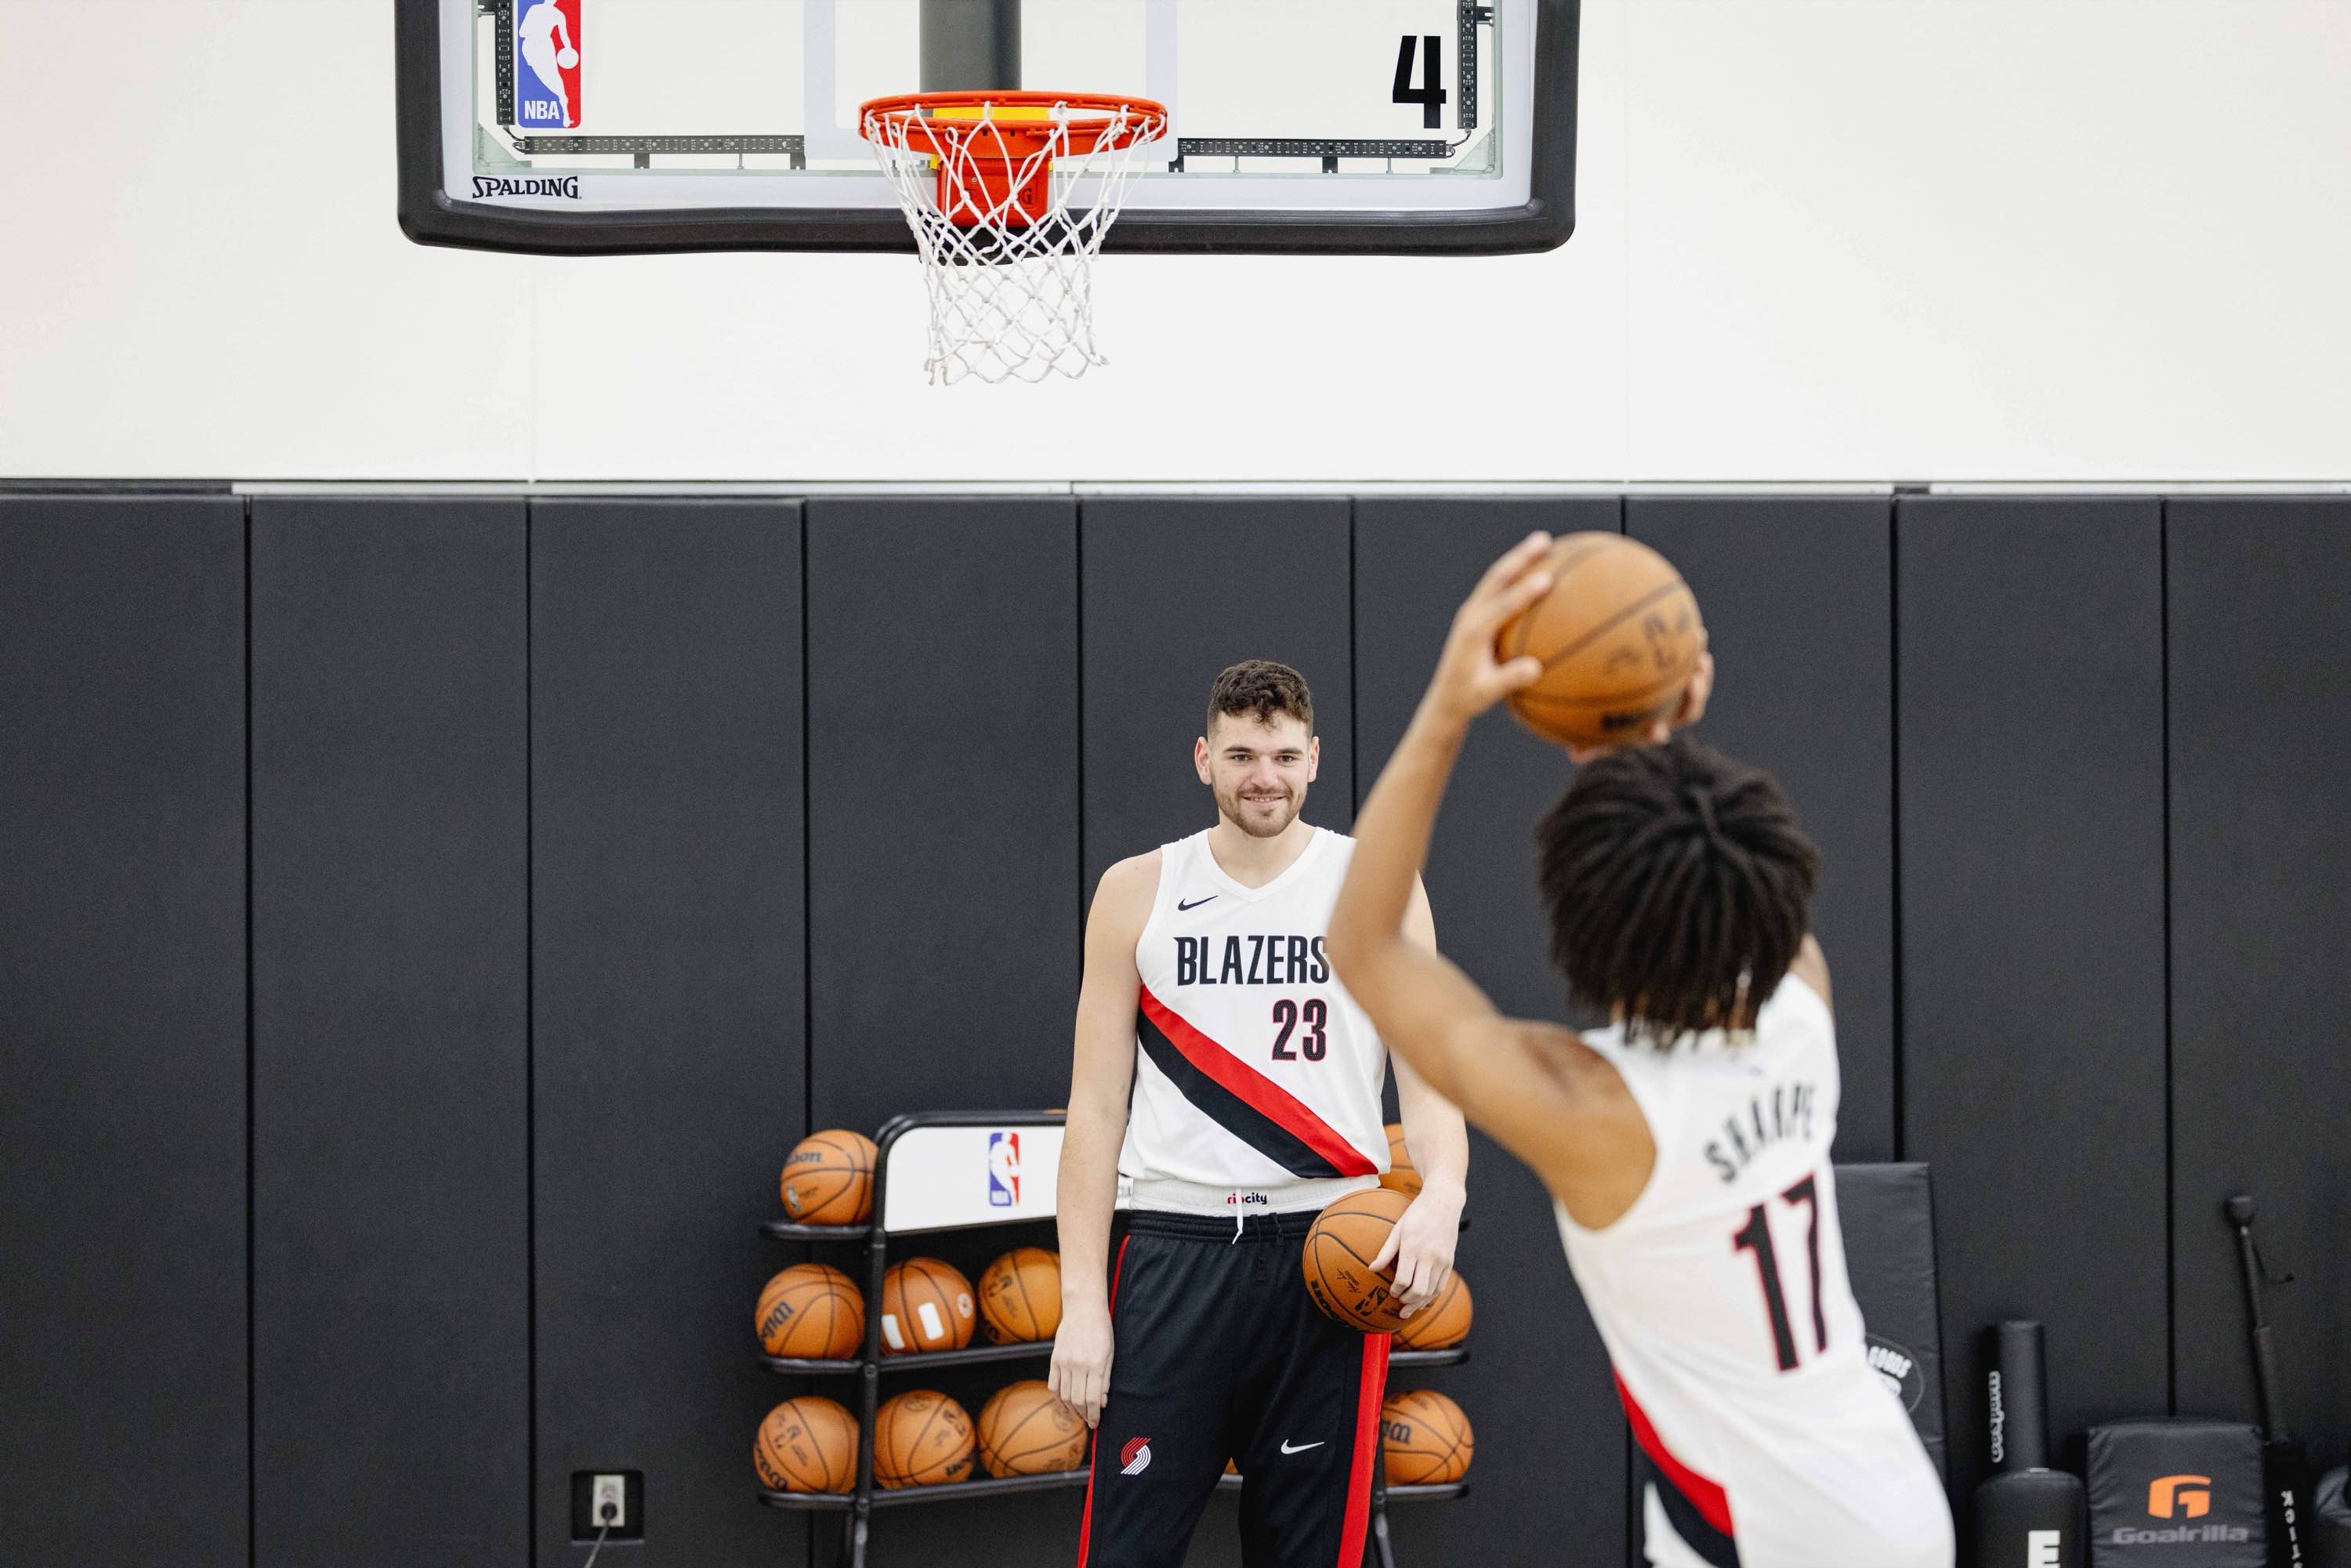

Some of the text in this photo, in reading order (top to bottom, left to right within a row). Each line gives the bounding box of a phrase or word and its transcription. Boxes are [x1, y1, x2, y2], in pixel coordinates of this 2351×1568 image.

[1393, 35, 1447, 129] 4
[523, 100, 560, 121] NBA
[472, 175, 580, 200] SPALDING
[1173, 935, 1330, 986] BLAZERS
[1271, 998, 1328, 1062] 23
[1226, 1191, 1268, 1205] ricity
[1732, 1171, 1828, 1372] 17
[2111, 1523, 2250, 1545] Goalrilla
